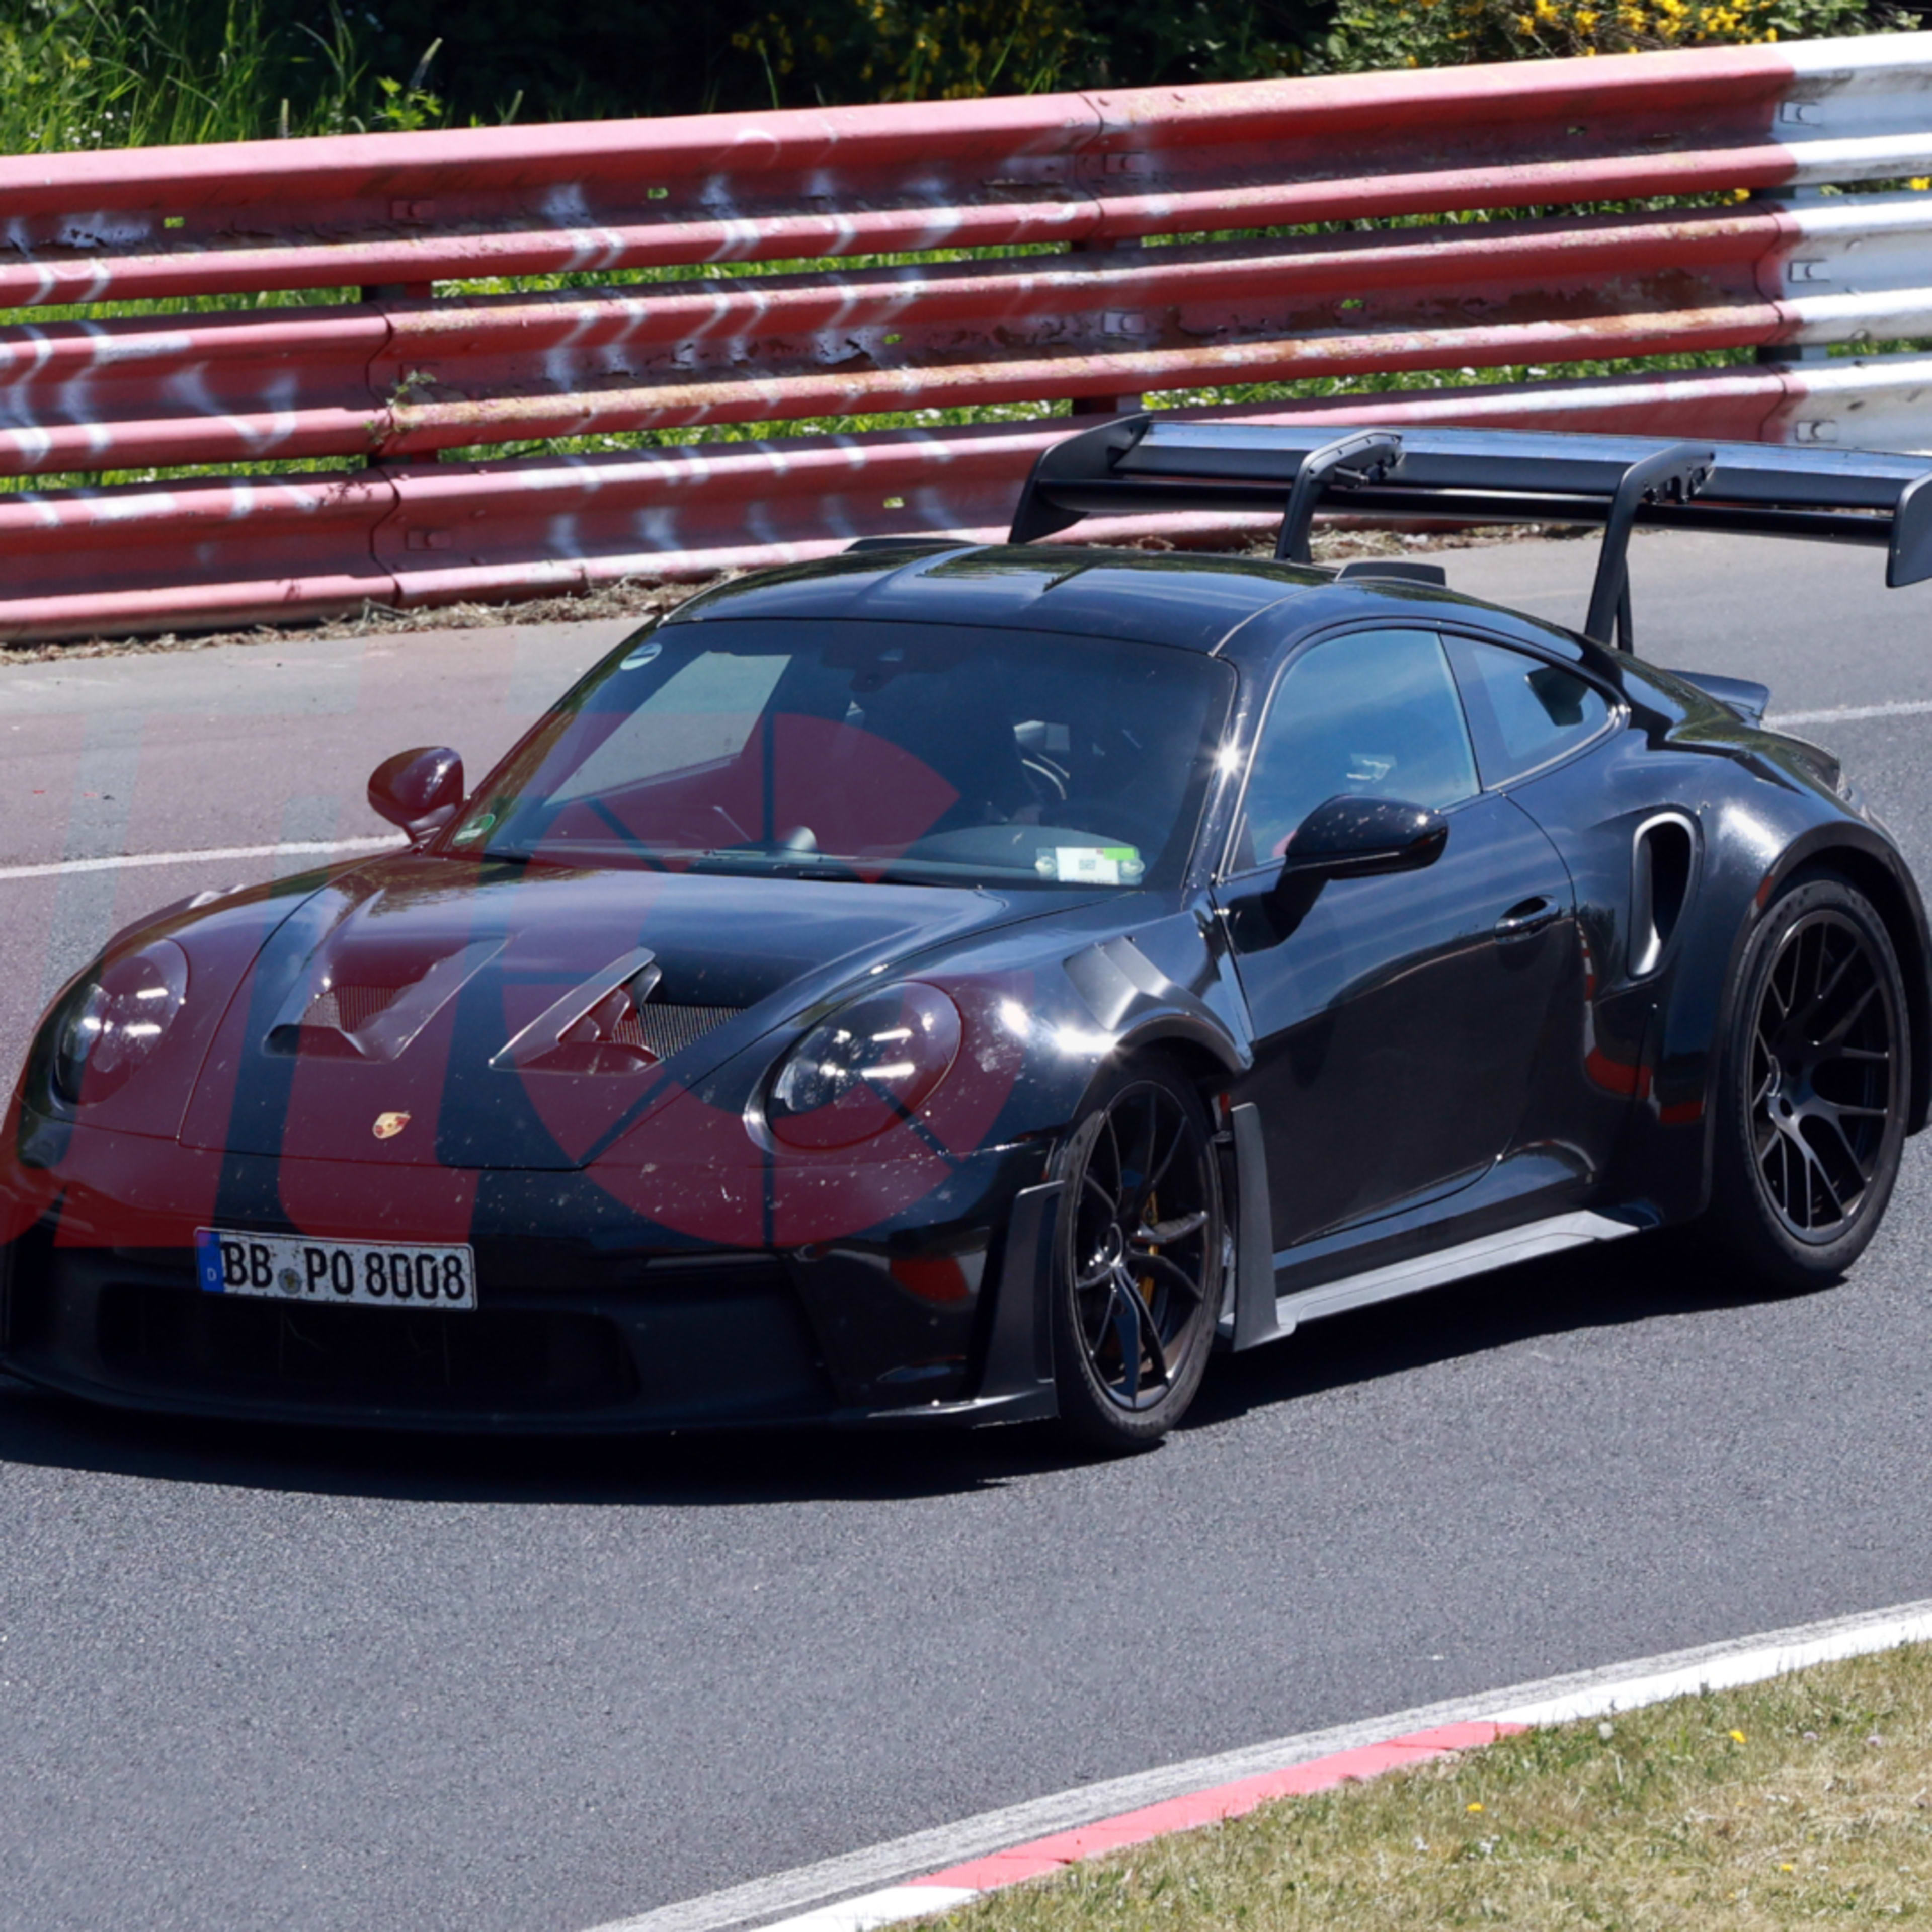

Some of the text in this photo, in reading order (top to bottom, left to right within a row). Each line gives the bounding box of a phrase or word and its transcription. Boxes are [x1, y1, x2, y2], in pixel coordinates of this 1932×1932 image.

[207, 1267, 217, 1281] D
[220, 1242, 466, 1300] BB PO 8008
